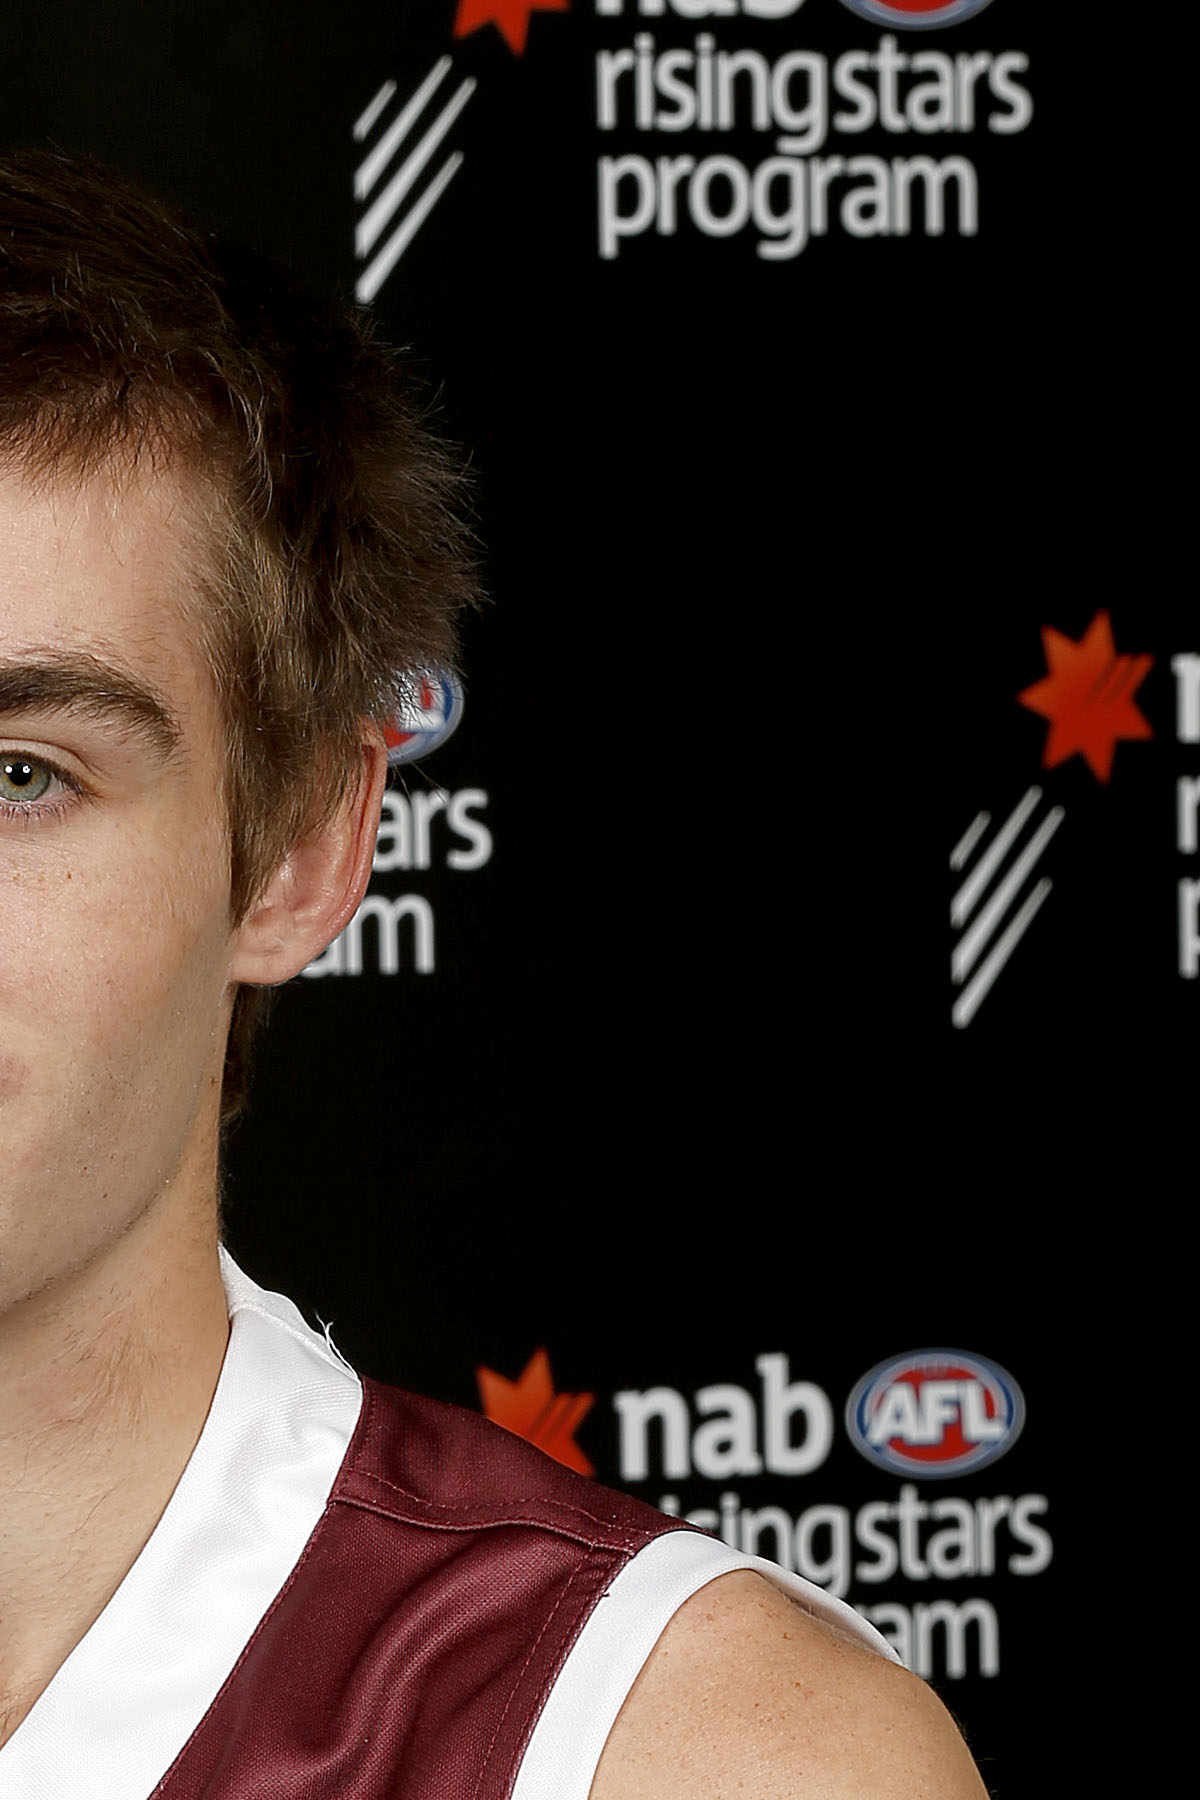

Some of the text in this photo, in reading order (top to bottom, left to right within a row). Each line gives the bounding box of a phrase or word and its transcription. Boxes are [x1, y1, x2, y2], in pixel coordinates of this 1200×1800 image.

[599, 154, 978, 261] program
[614, 1352, 834, 1481] nab
[867, 1377, 1006, 1449] AFL
